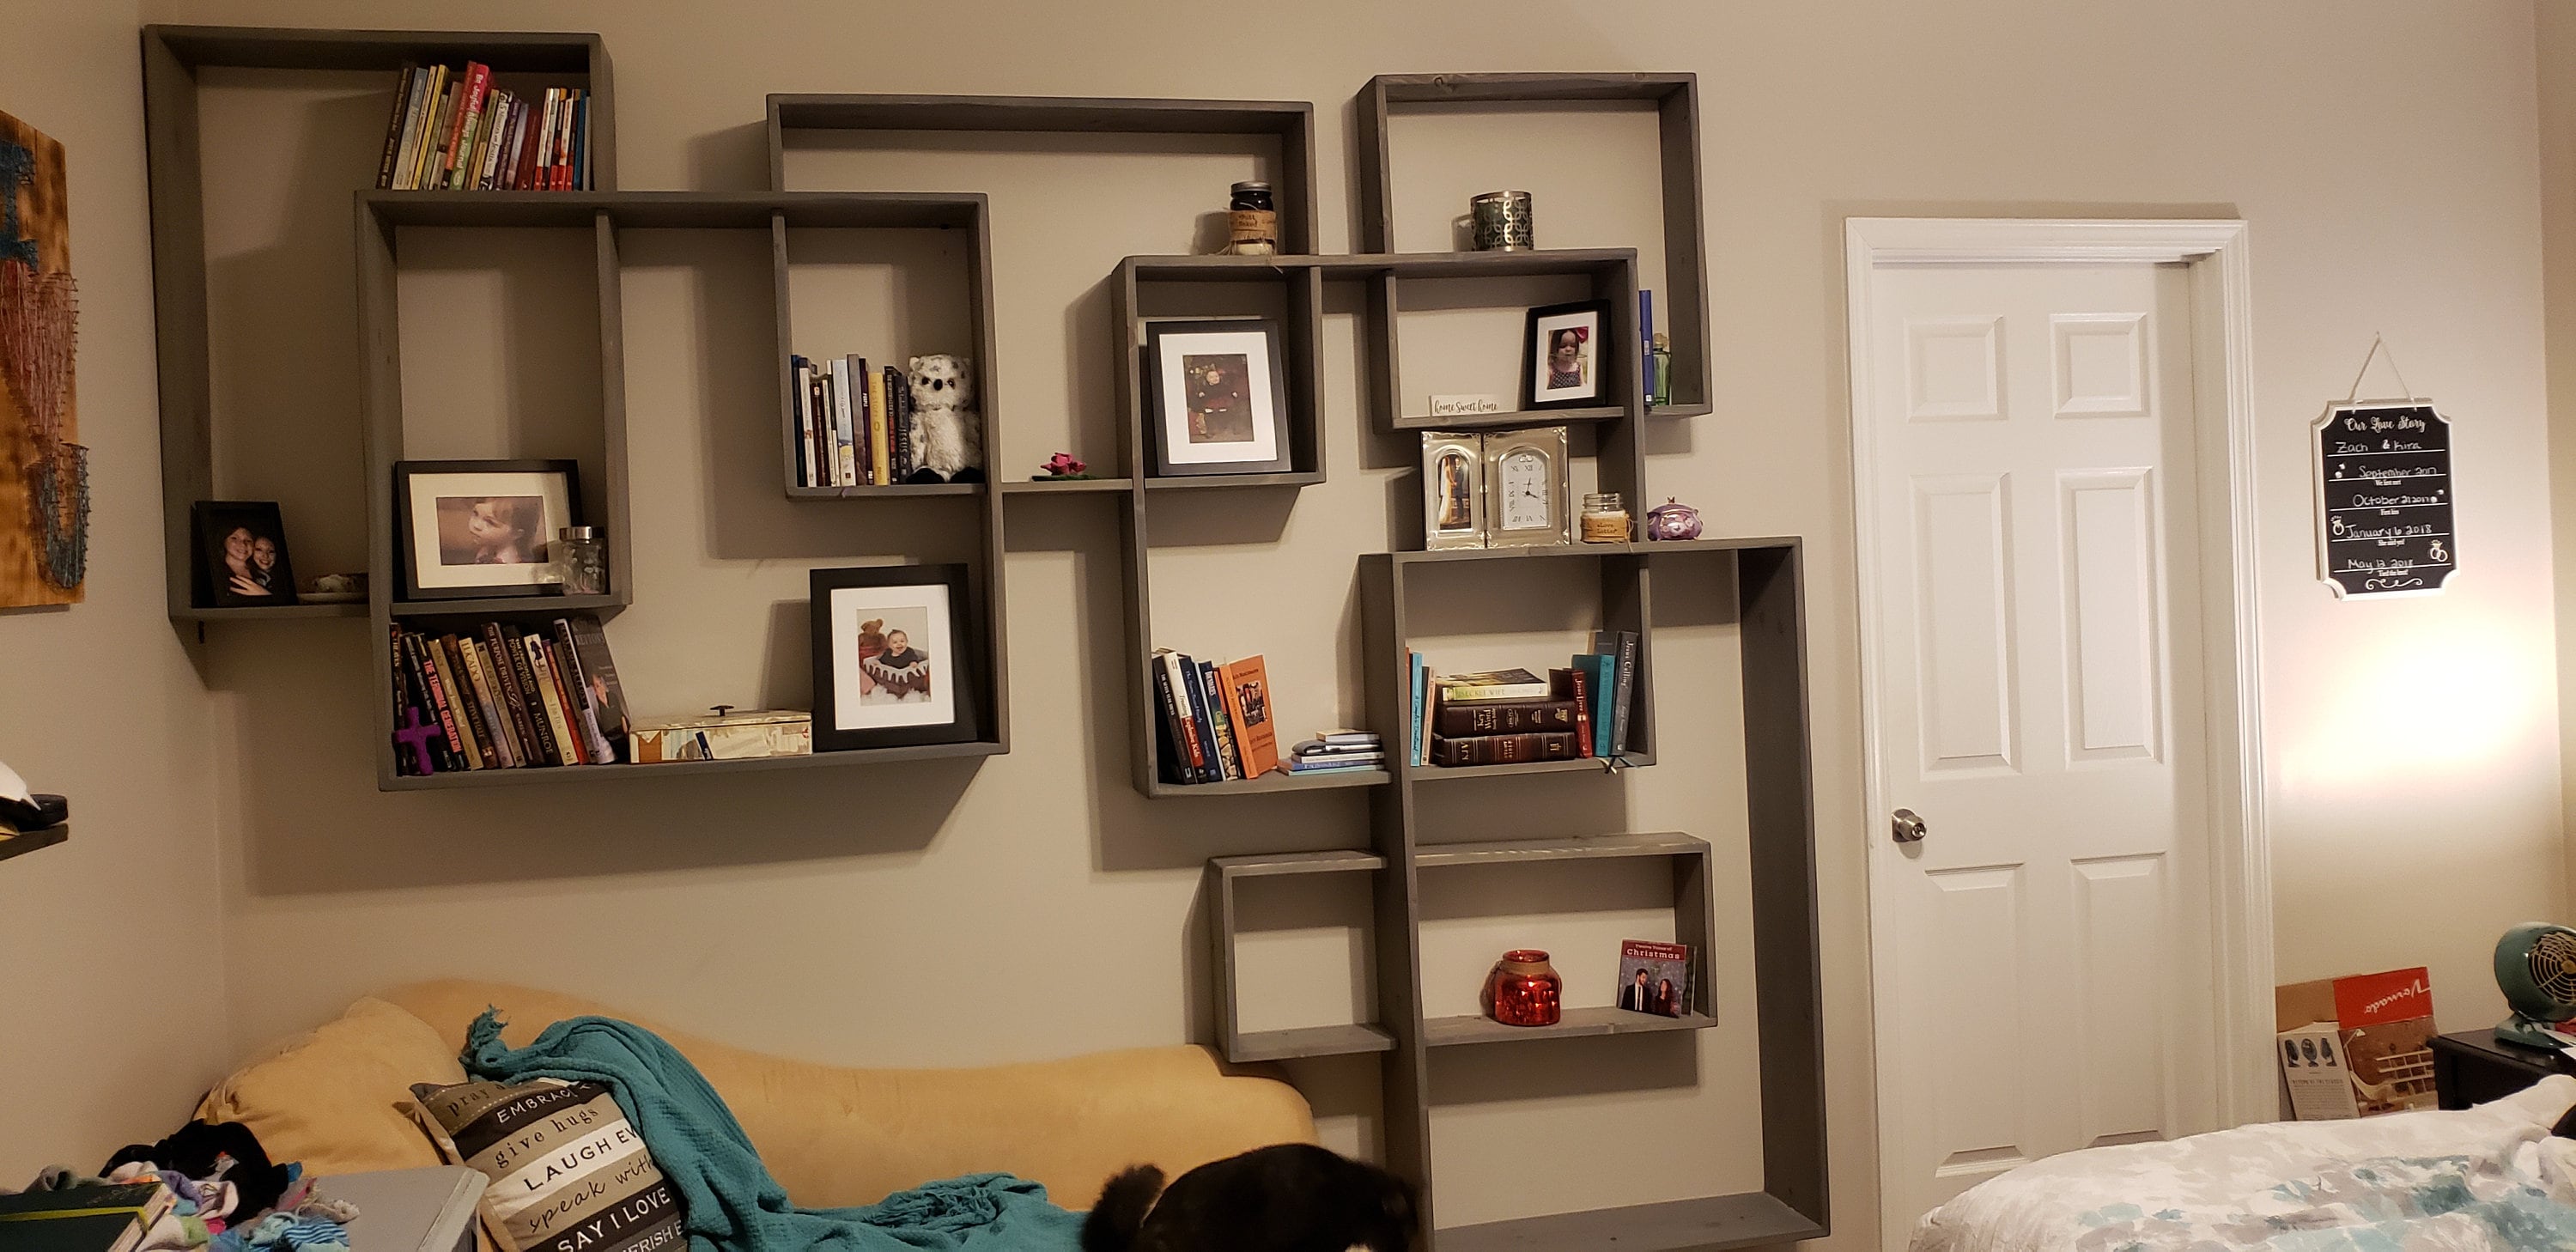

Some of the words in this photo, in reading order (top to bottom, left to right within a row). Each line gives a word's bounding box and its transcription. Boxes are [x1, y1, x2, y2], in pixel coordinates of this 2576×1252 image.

[474, 73, 483, 83] Be
[466, 84, 480, 109] Joyful
[460, 111, 474, 137] Always
[455, 139, 468, 168] Journal
[487, 142, 499, 162] Jesus
[1435, 399, 1455, 413] home
[1478, 399, 1498, 412] home
[2344, 417, 2367, 431] Our
[2371, 416, 2394, 433] Love
[2398, 416, 2426, 432] Story
[898, 428, 907, 453] JESUS
[2336, 441, 2368, 453] Zach
[2394, 441, 2421, 451] Kira
[2359, 465, 2411, 478] September
[2353, 494, 2399, 507] October
[2345, 524, 2392, 540] January
[2395, 526, 2402, 535] 6
[2406, 525, 2433, 534] 2018
[2348, 559, 2373, 574] May
[2391, 559, 2413, 568] 2018
[486, 625, 495, 636] THE
[489, 636, 504, 665] PURPOSE
[1624, 640, 1633, 659] Jesus
[422, 659, 435, 675] THE
[460, 641, 482, 682] LUCADO
[507, 637, 520, 661] POWER
[515, 660, 523, 671] OF
[519, 671, 531, 695] VISION
[498, 666, 513, 691] DRIVEN
[1620, 660, 1631, 687] Calling
[427, 673, 448, 710] TERMINAL
[1574, 678, 1583, 696] Jesus
[1576, 695, 1585, 711] Lives
[1477, 711, 1485, 728] Key
[1484, 709, 1492, 730] Word
[439, 708, 463, 753] GENERATION
[532, 711, 554, 755] MUNROE
[1191, 743, 1201, 757] Kids
[1460, 741, 1468, 761] KJV
[1627, 948, 1680, 959] Christmas
[2364, 979, 2430, 1014] Vornado
[447, 1089, 490, 1117] pray
[495, 1128, 545, 1169] give
[555, 1107, 598, 1132] hugs
[524, 1138, 612, 1191] LAUGH
[617, 1125, 638, 1144] EV
[530, 1181, 606, 1233] speak
[614, 1152, 653, 1184] with
[557, 1221, 605, 1252] SAY
[610, 1212, 621, 1229] I
[623, 1187, 671, 1222] LOVE
